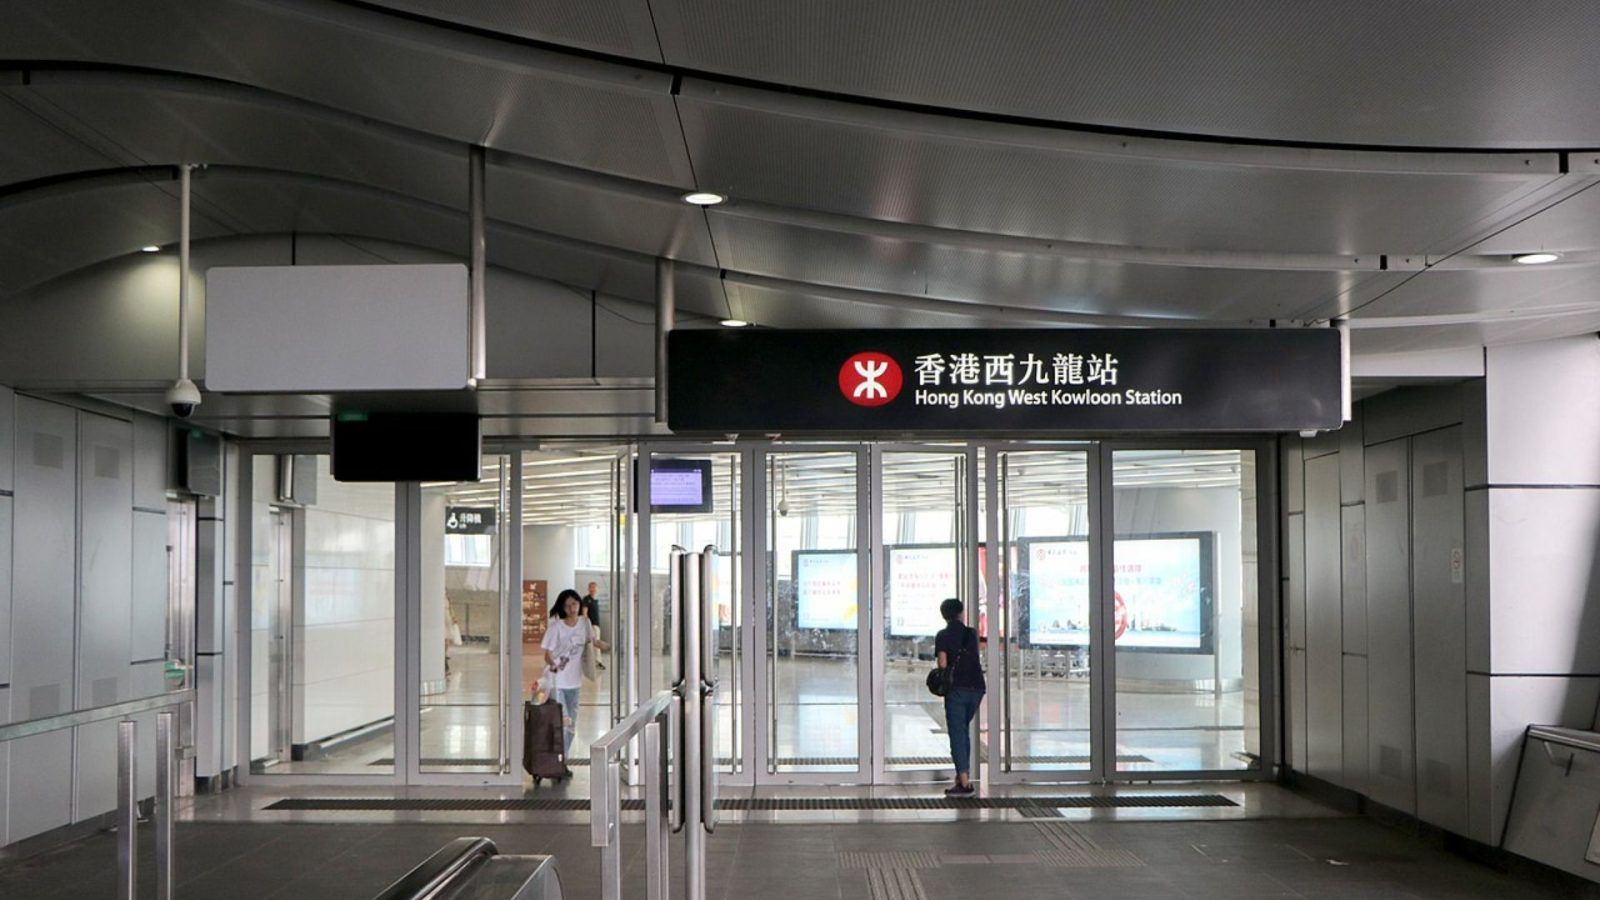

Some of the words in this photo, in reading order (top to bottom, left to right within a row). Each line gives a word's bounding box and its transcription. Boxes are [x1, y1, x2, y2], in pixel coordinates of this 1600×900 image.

[914, 352, 1119, 386] 香港西九龍站
[914, 389, 960, 409] Hong
[962, 389, 1006, 409] Kong
[1007, 388, 1048, 406] West
[1051, 388, 1122, 406] Kowloon
[1125, 388, 1183, 406] Station
